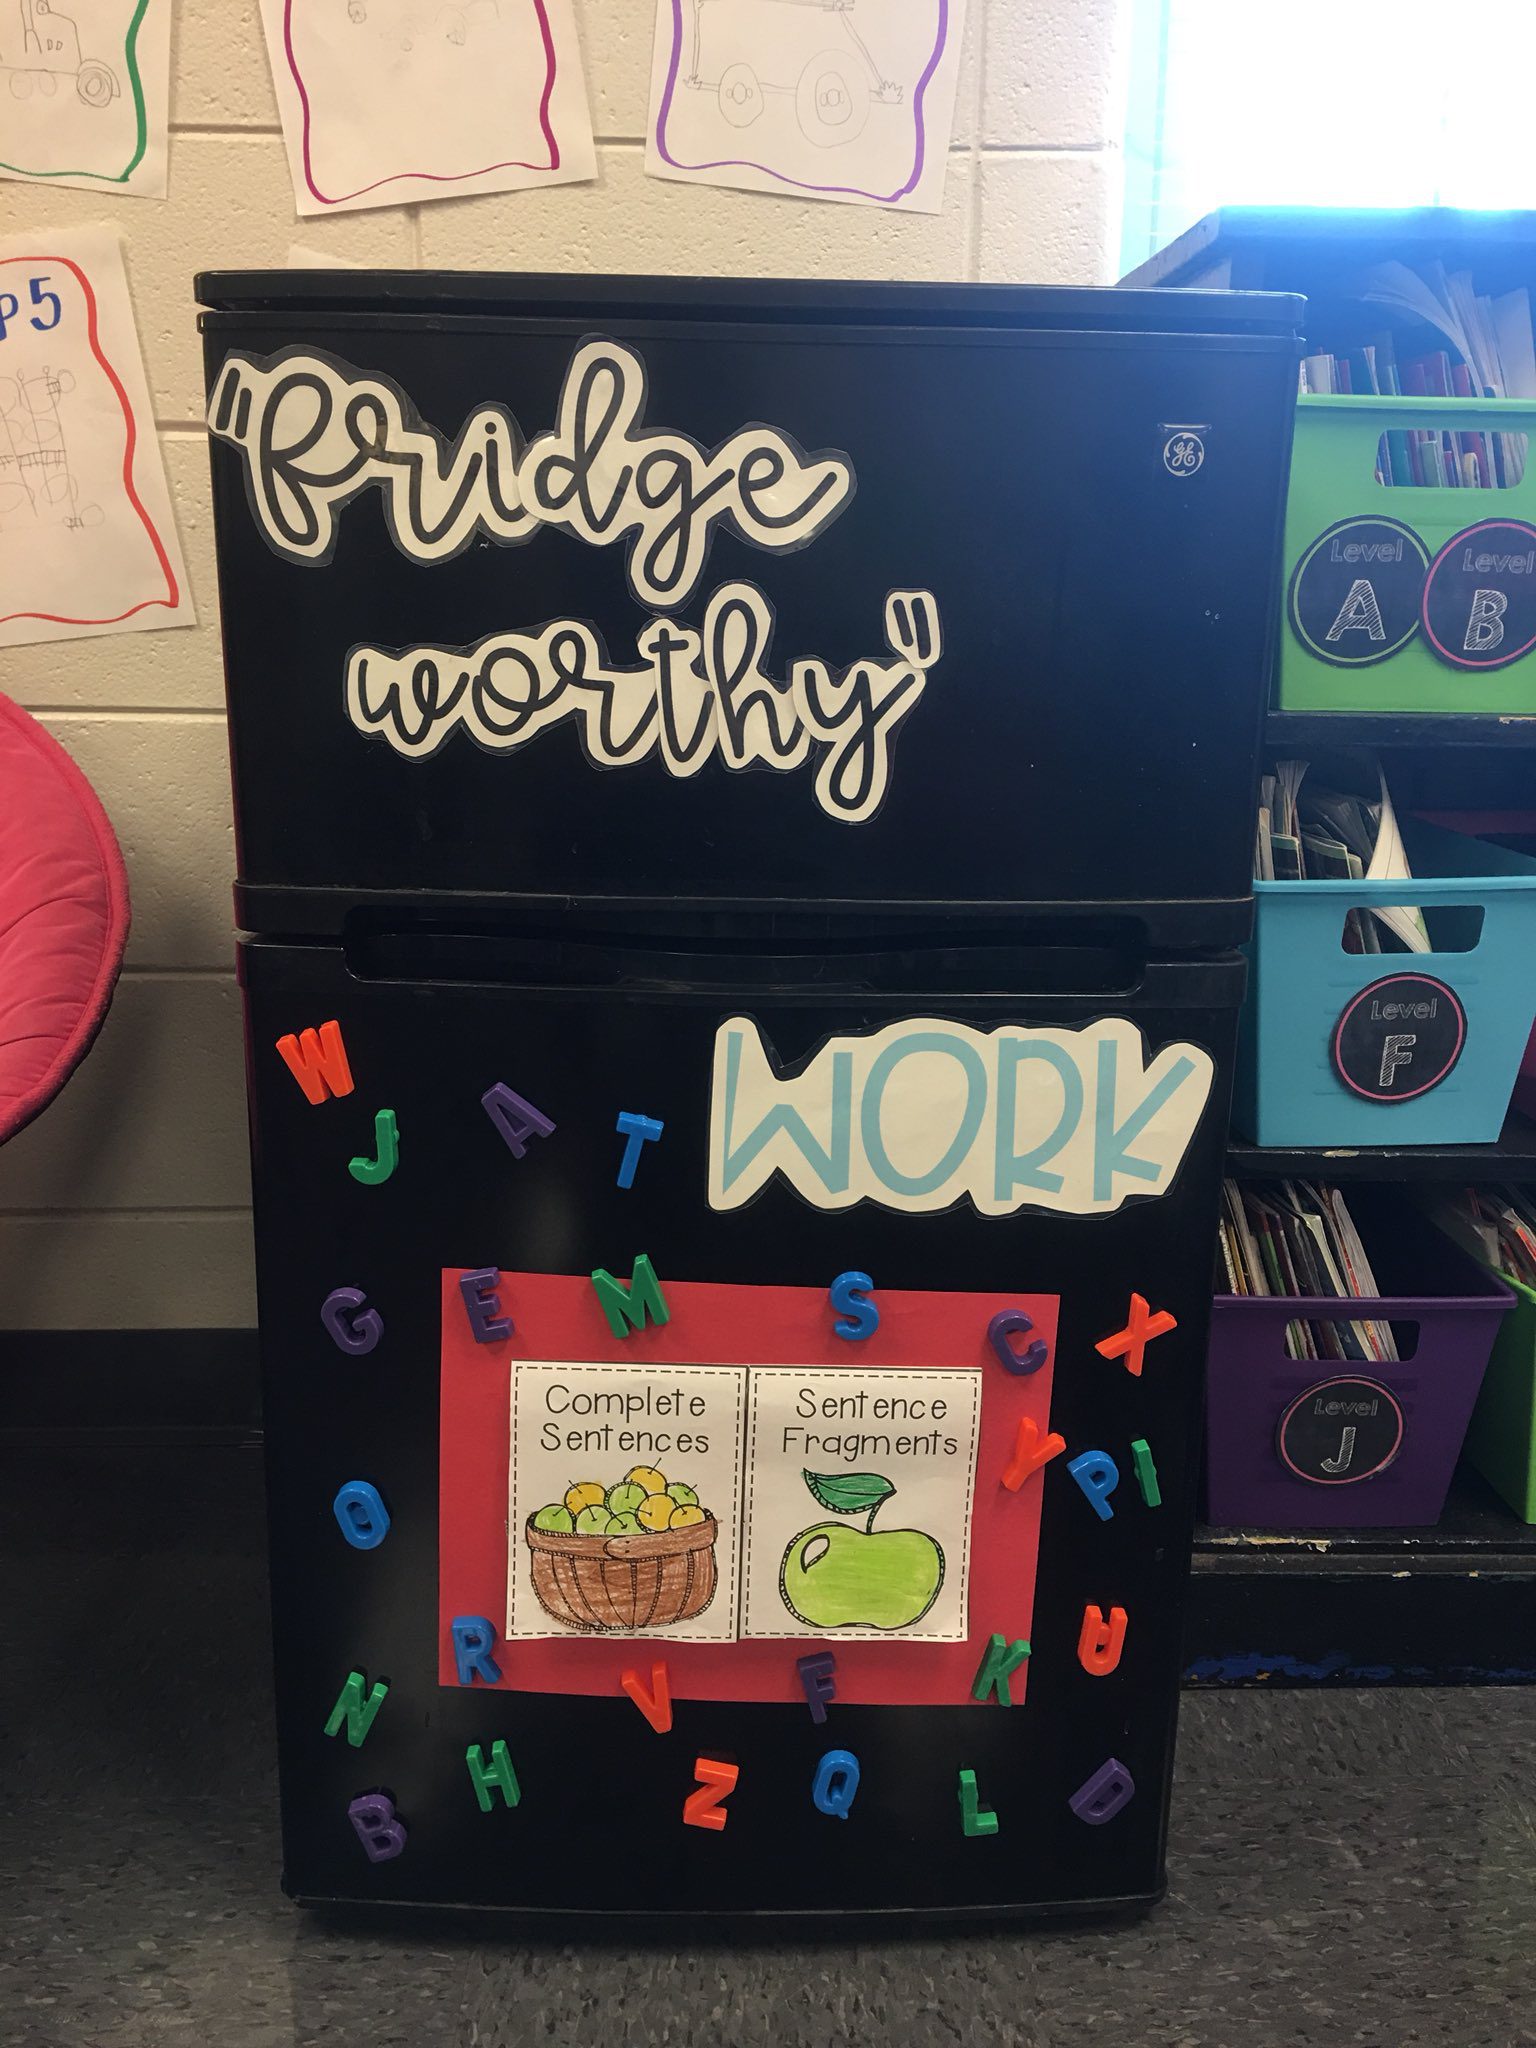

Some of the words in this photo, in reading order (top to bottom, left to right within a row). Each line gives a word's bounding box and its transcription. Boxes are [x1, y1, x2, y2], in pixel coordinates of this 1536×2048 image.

[1330, 538, 1404, 563] Level
[1462, 547, 1536, 574] Level
[1325, 579, 1387, 642] A
[1462, 588, 1509, 651] B
[1370, 997, 1438, 1021] Level
[276, 1020, 354, 1105] W
[1378, 1034, 1417, 1087] F
[348, 1109, 399, 1185] J
[481, 1082, 556, 1159] A
[616, 1112, 664, 1189] T
[722, 1031, 1197, 1202] WORK
[321, 1287, 384, 1355] G
[460, 1267, 514, 1343] E
[592, 1254, 671, 1338] M
[830, 1271, 879, 1340] S
[987, 1309, 1048, 1376] C
[1095, 1293, 1177, 1376] X
[539, 1422, 710, 1454] Sentences
[545, 1384, 706, 1423] Complete
[796, 1388, 948, 1421] Sentence
[1313, 1397, 1380, 1417] Level
[782, 1426, 958, 1462] Fragments
[1002, 1417, 1066, 1492] Y
[1320, 1426, 1357, 1473] J
[1067, 1450, 1119, 1521] P
[452, 1616, 501, 1684] R
[972, 1634, 1031, 1707] K
[1078, 1605, 1128, 1676] U
[324, 1671, 388, 1748] N
[620, 1661, 672, 1733] V
[797, 1651, 837, 1724] F
[466, 1740, 520, 1812] H
[683, 1758, 739, 1831] Z
[813, 1750, 860, 1819] Q
[958, 1769, 998, 1836] L
[1068, 1757, 1135, 1825] D
[348, 1794, 407, 1863] B
